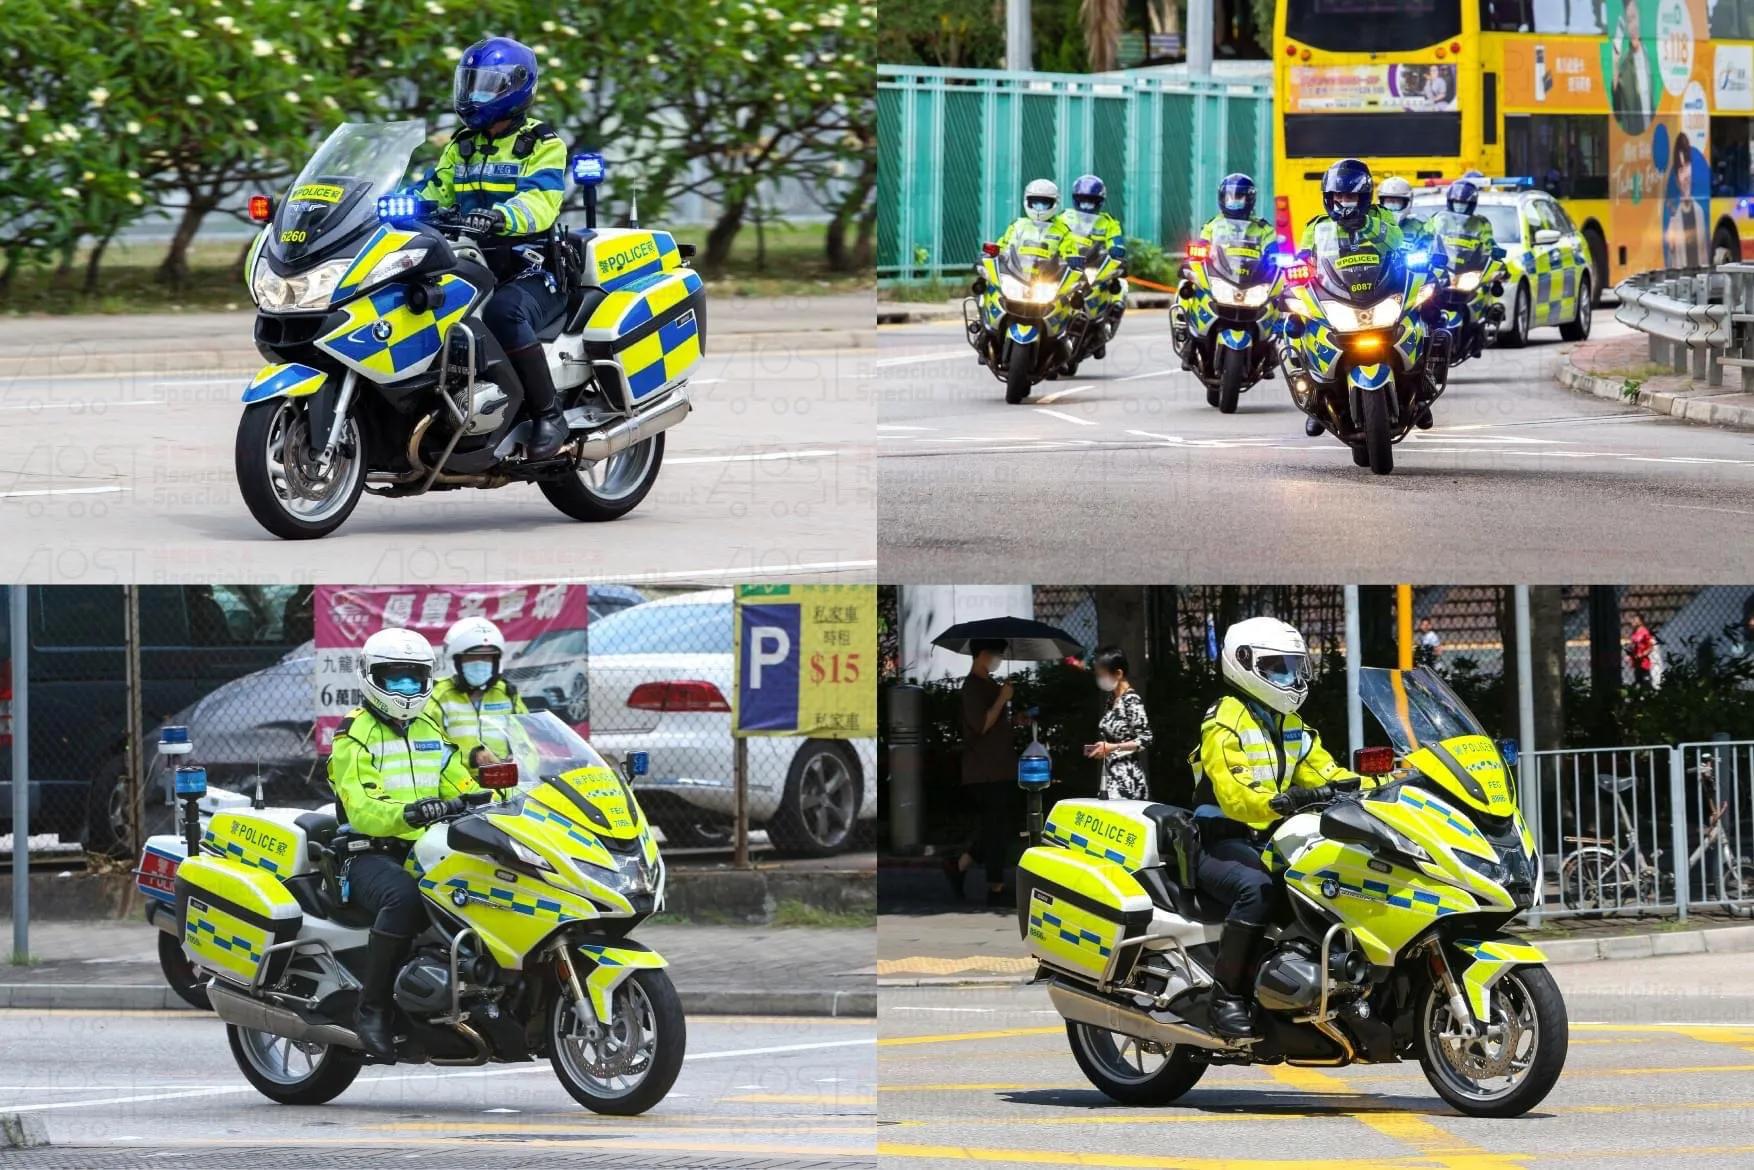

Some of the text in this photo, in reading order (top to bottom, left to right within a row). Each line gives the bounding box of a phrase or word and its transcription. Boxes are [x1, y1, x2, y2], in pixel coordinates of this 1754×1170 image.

[281, 230, 306, 243] 6260
[608, 243, 649, 271] POLICE
[1342, 256, 1373, 266] POLICE
[1351, 283, 1373, 293] 6087
[750, 626, 790, 689] P
[810, 650, 860, 685] $15
[239, 824, 277, 852] POLICE
[1083, 815, 1126, 843] POLICE
